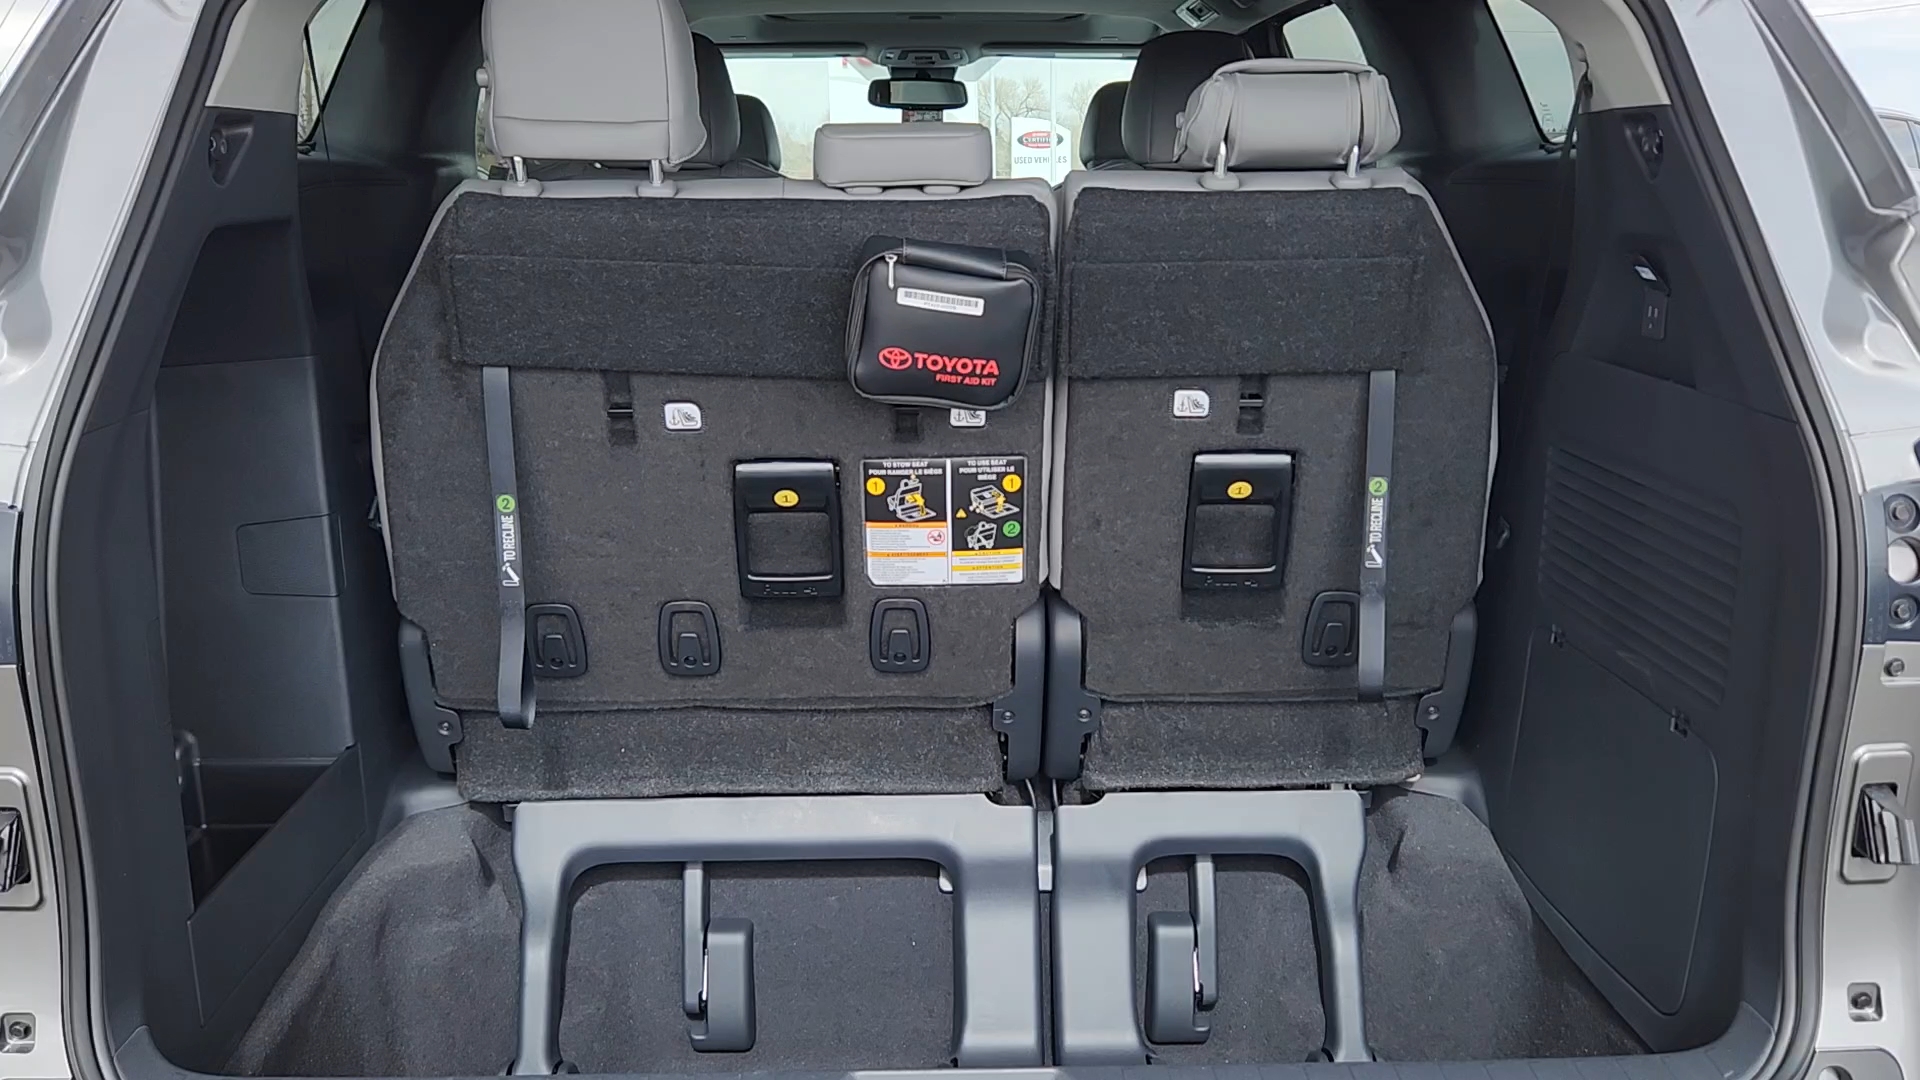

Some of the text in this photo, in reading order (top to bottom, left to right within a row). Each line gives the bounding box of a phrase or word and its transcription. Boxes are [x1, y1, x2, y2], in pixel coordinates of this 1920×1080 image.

[1014, 156, 1068, 164] USED VEHIES
[914, 351, 1000, 376] TOYOTA
[935, 373, 998, 387] FIRST AID KIT
[1374, 481, 1382, 492] 2
[501, 497, 511, 510] 2
[1369, 497, 1384, 543] TO RECLINE
[1007, 523, 1016, 534] 2
[501, 514, 516, 562] TO RECLINE
